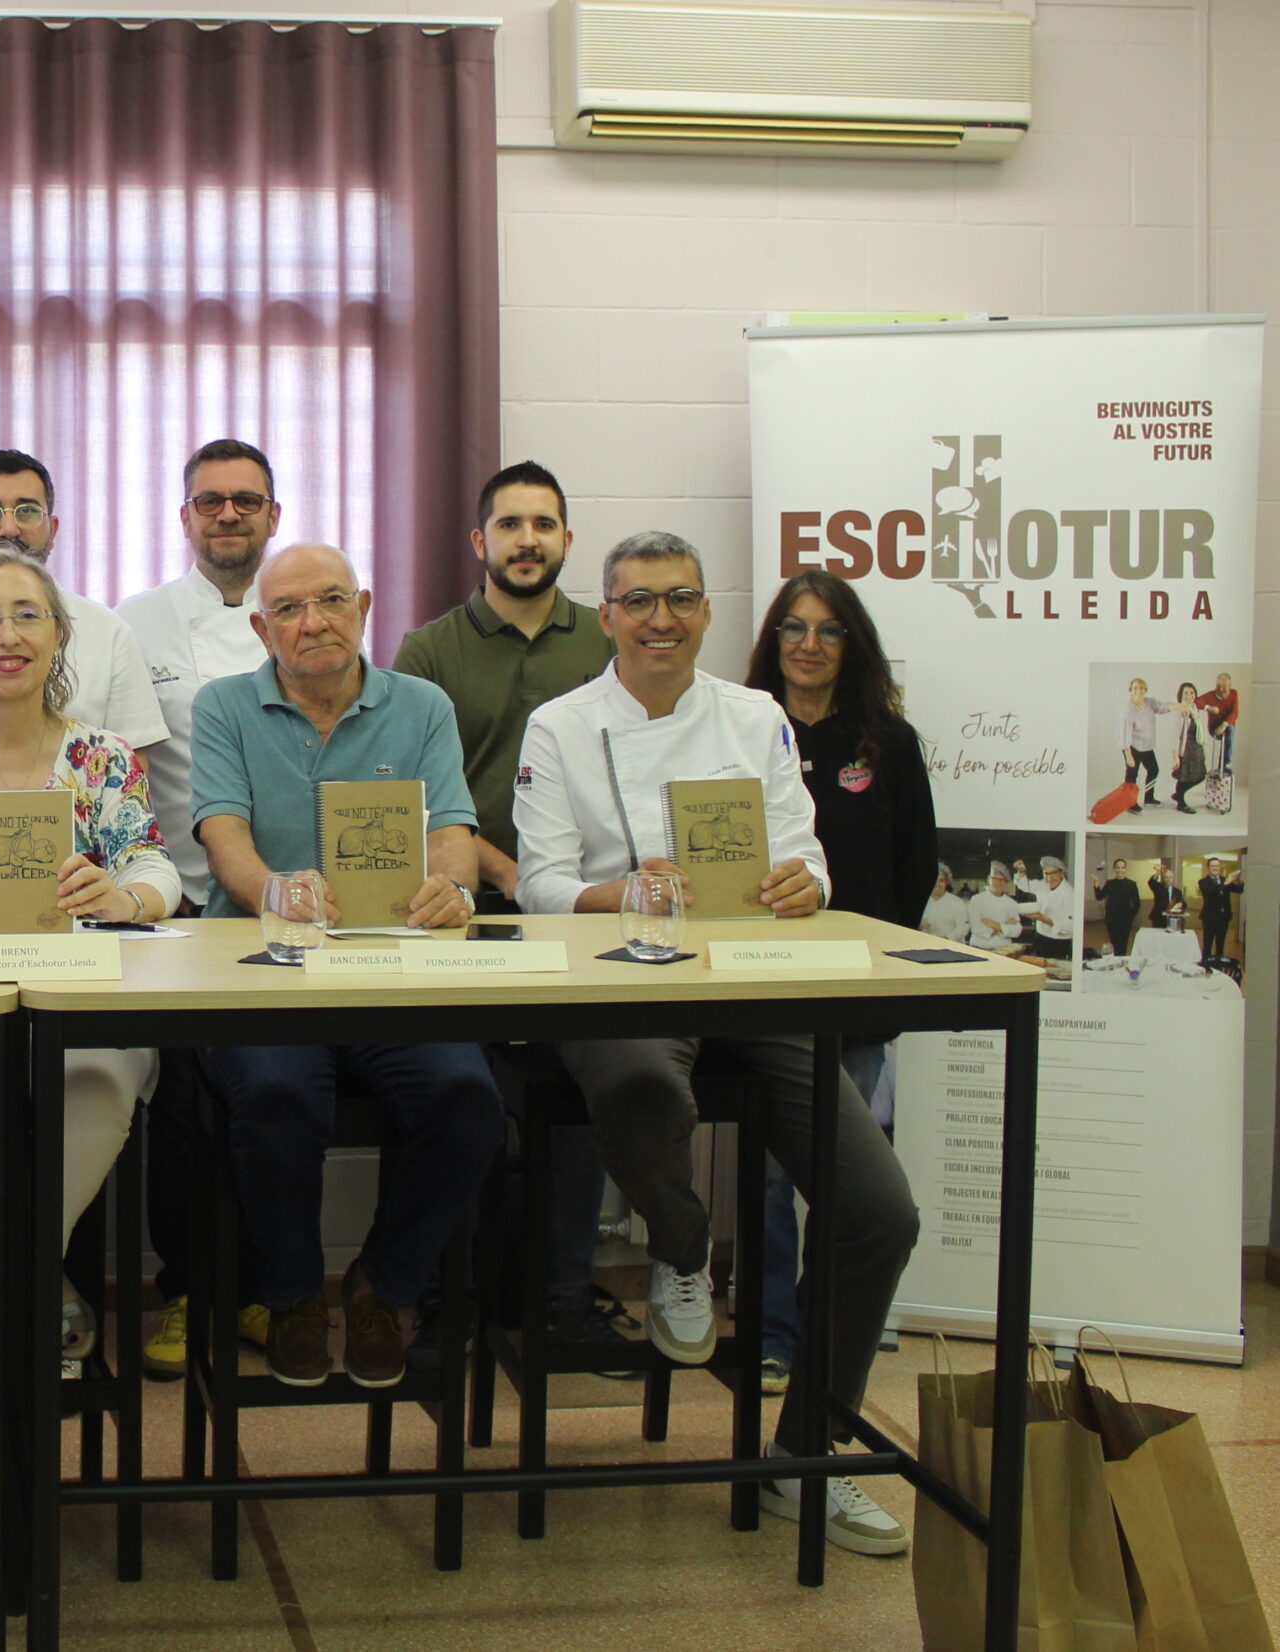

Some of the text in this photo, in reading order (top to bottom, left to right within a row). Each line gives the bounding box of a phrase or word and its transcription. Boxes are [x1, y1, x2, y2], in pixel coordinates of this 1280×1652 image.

[1097, 400, 1213, 419] BENVINGUTS
[1113, 422, 1213, 440] AL VOSTRE
[1153, 444, 1213, 461] FUTUR
[1006, 590, 1214, 620] LLEIDA
[961, 712, 1021, 742] Junts
[928, 746, 1068, 786] ho fem possible
[0, 817, 13, 828] NO
[374, 858, 410, 869] CEBA
[21, 868, 58, 880] CEBA
[1, 948, 40, 956] BRENUY
[733, 951, 793, 960] CUINA AMIGA
[19, 959, 67, 968] d'Eschotur
[69, 959, 97, 967] Lleida
[329, 956, 355, 965] BANC
[357, 956, 381, 964] DELS
[426, 957, 474, 967] FUNDACIÓ
[946, 1112, 978, 1124] PROJECTE
[945, 1138, 967, 1148] CLIMA
[968, 1139, 995, 1149] POSITIU
[944, 1162, 969, 1172] ESCOLA
[1045, 1169, 1071, 1180] GLOBAL
[943, 1186, 980, 1198] PROJECTES
[942, 1211, 970, 1222] TREBALL
[971, 1213, 981, 1223] EN
[941, 1236, 972, 1247] QUALITAT
